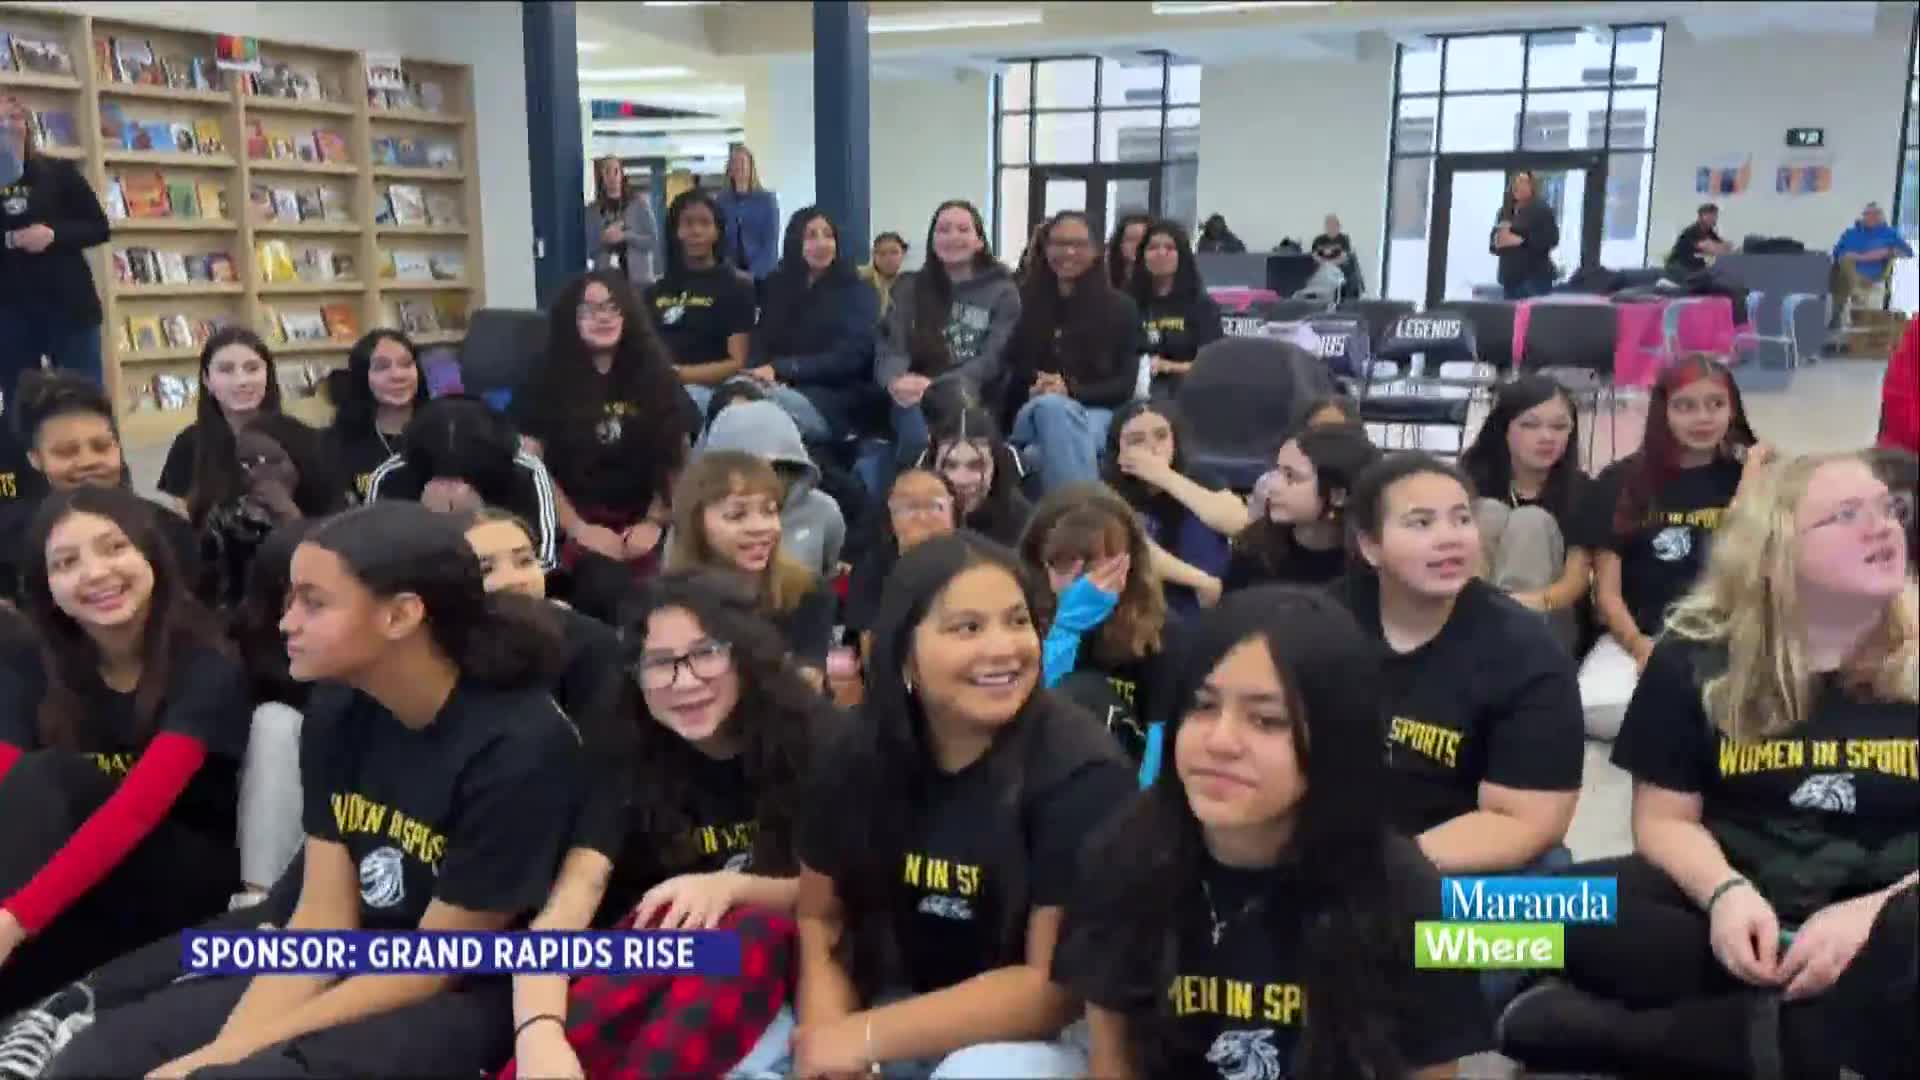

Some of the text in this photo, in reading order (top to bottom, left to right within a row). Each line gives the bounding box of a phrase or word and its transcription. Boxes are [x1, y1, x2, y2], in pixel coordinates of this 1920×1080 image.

[1395, 319, 1461, 339] LEGENDS
[1389, 716, 1463, 768] SPORTS
[1719, 738, 1920, 781] WOMEN IN SPORT
[926, 858, 949, 889] IN
[1226, 978, 1253, 1019] IN
